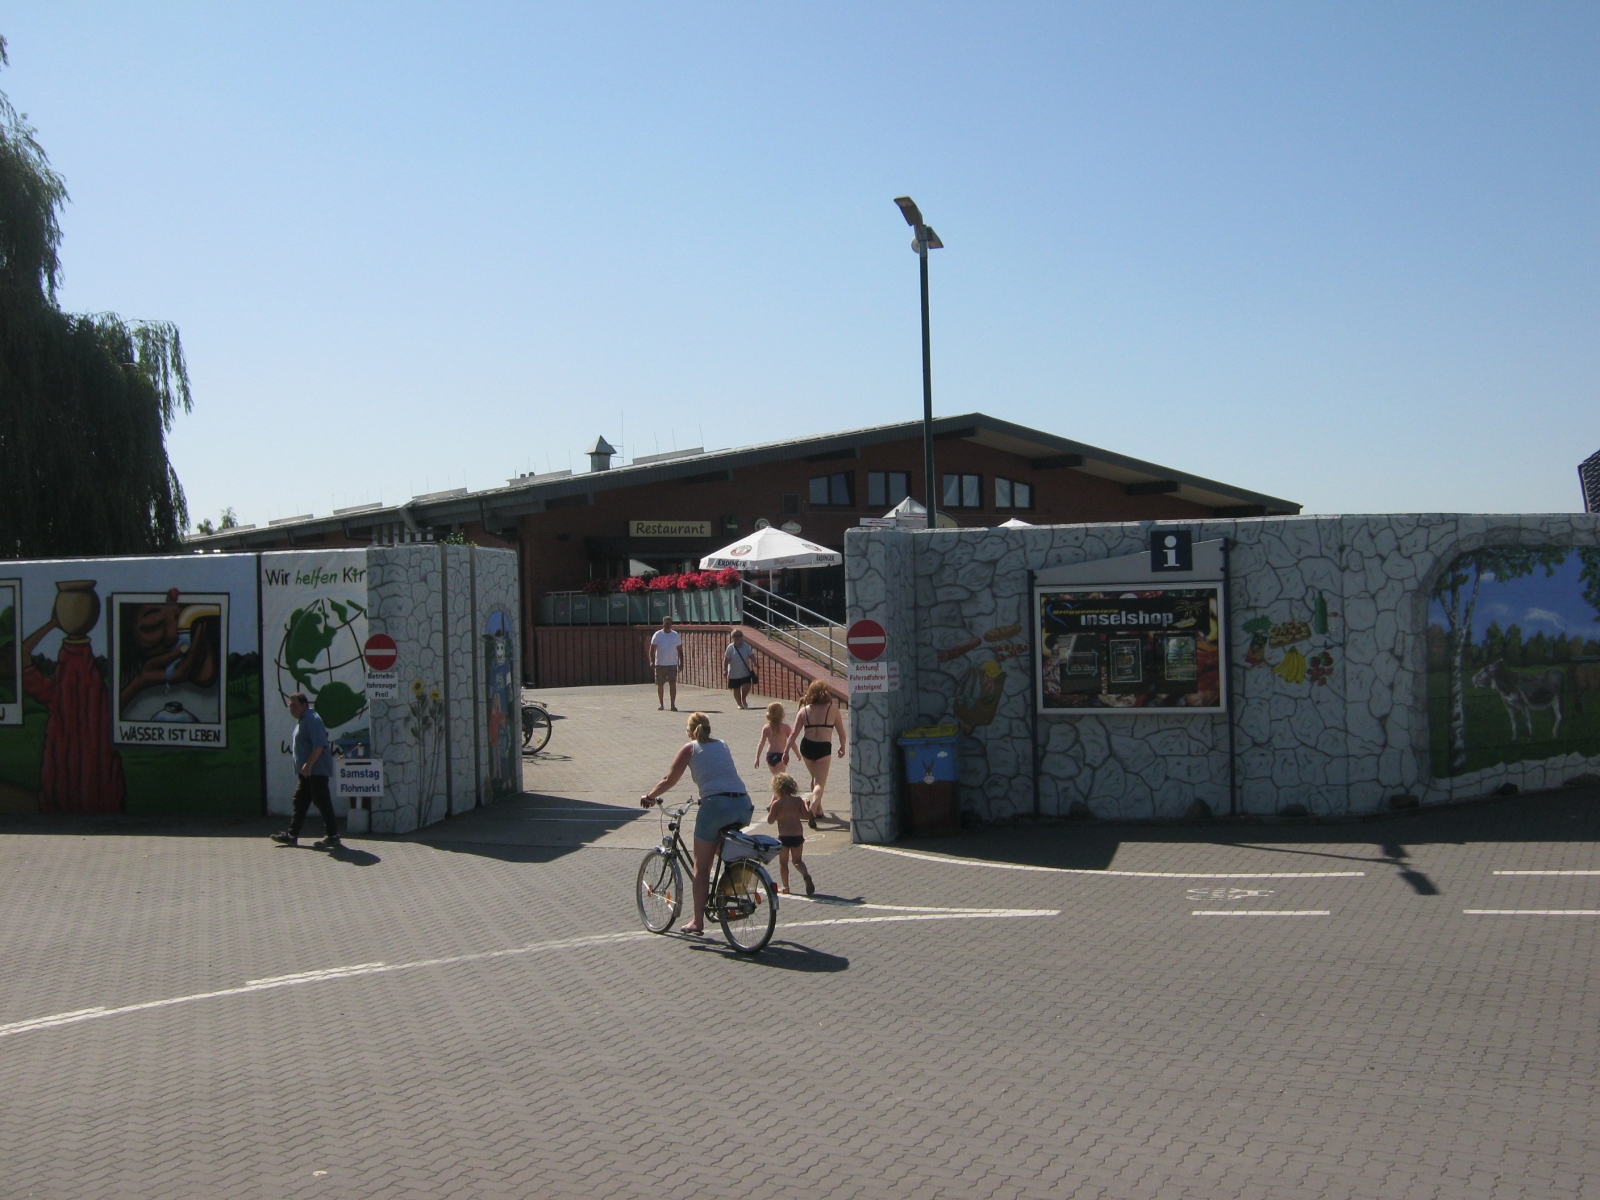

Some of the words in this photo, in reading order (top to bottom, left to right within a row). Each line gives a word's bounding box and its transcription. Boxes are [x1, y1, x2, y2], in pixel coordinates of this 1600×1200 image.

[636, 522, 705, 535] Restaurant
[816, 554, 835, 562] ERDINGER
[717, 559, 747, 568] ERDINGER
[265, 569, 290, 586] Wir
[295, 566, 338, 589] helfen
[856, 663, 879, 672] Achtung!
[366, 682, 397, 690] fahrzeuge
[855, 684, 882, 692] absteigen!
[119, 725, 165, 741] WASSER
[168, 728, 187, 741] IST
[189, 729, 221, 743] LEBEN
[340, 769, 380, 780] Samstag
[340, 784, 381, 793] Flohmarkt
